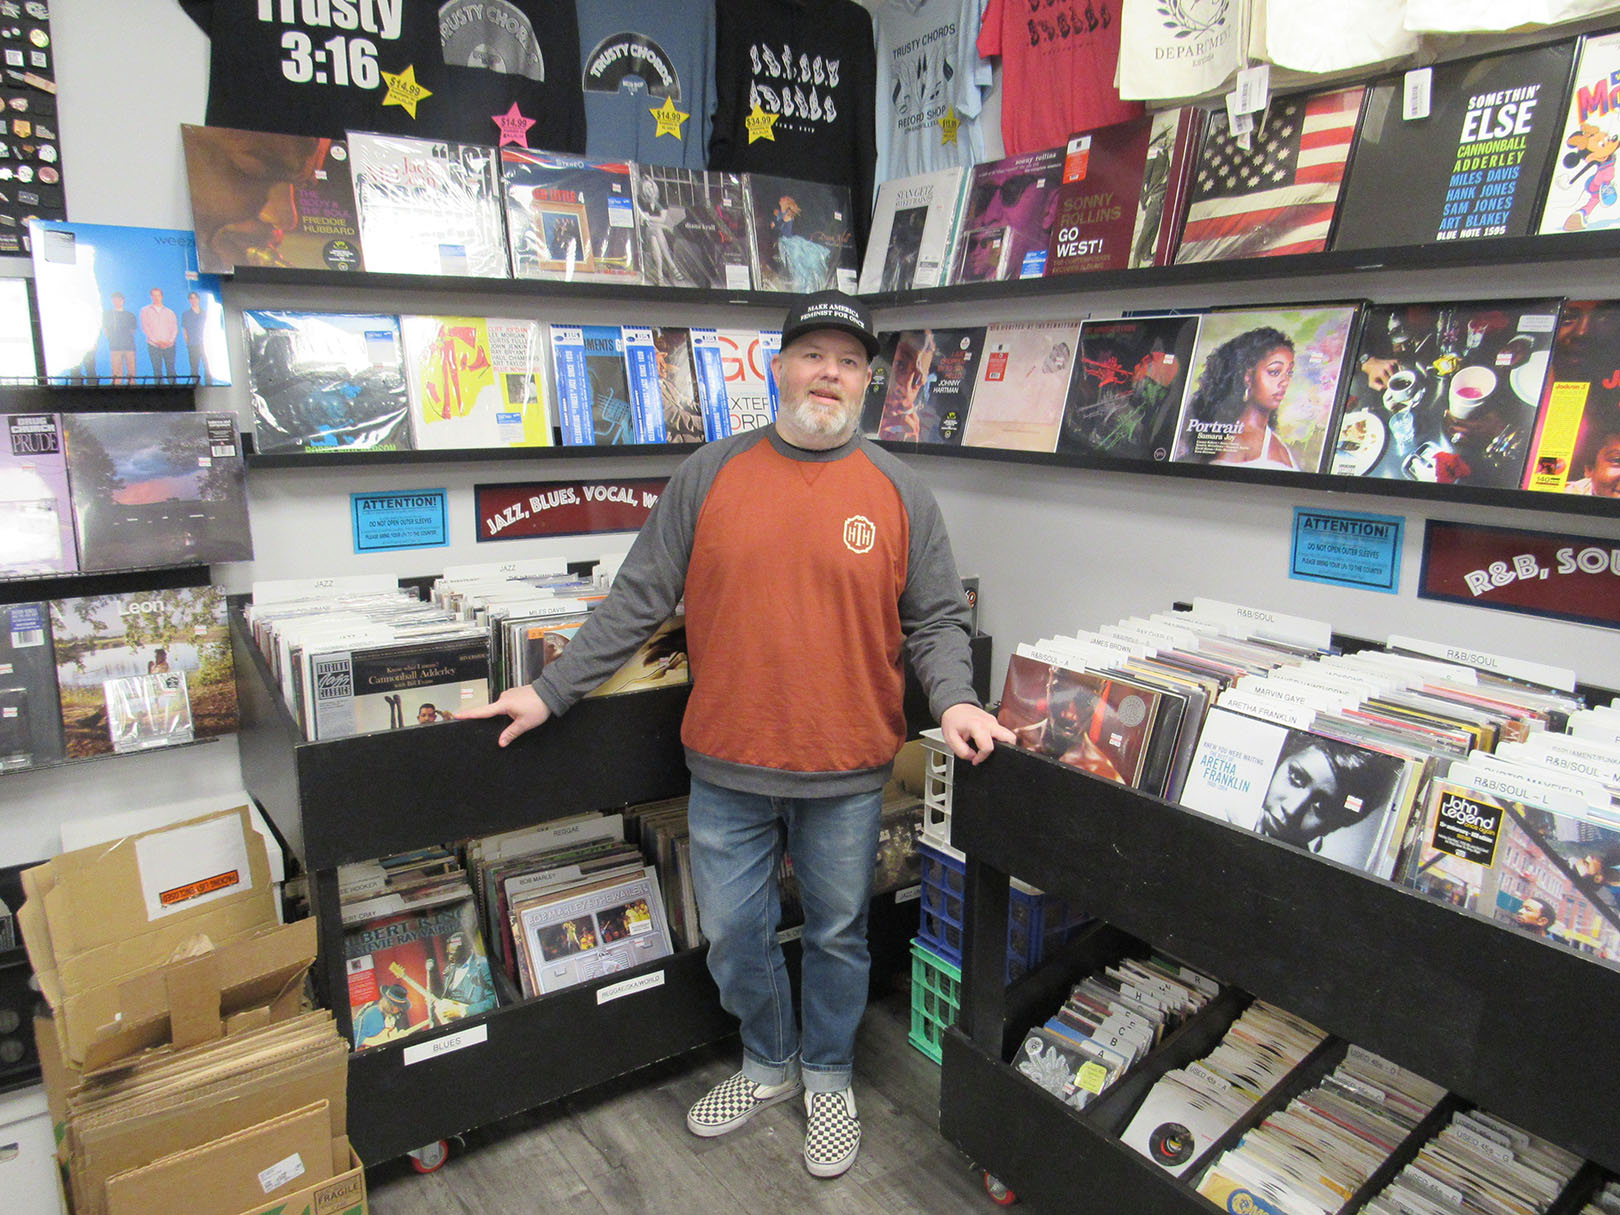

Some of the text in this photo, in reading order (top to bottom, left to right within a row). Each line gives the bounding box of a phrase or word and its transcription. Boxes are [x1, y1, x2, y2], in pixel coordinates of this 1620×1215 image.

[440, 4, 484, 48] RUSTY
[893, 24, 956, 60] TRUSTY CHORDS
[281, 31, 380, 90] 3:16
[590, 43, 673, 87] TRUSTY CHORDS
[389, 76, 422, 97] $14.99
[1468, 84, 1541, 111] SOMETHIN'
[501, 118, 527, 129] $14.99
[657, 111, 681, 121] $14.99
[747, 116, 771, 127] $34.99
[898, 111, 925, 129] RECORD
[926, 105, 946, 121] SHOP
[1460, 99, 1538, 144] ELSE
[1457, 136, 1526, 159] CANNONBALL
[1015, 152, 1057, 166] sonny rollins
[1453, 150, 1526, 173] ADDERLEY
[1449, 166, 1521, 188] MILES DAVIS
[550, 189, 585, 204] LITTLE 4
[1446, 181, 1517, 202] HANK JONES
[1063, 192, 1113, 211] SONNY
[1442, 196, 1514, 216] SAM JONES
[303, 216, 346, 226] FREDDIE
[1060, 206, 1121, 226] ROLLINS
[1439, 211, 1510, 230] ART BLAKEY
[304, 225, 355, 235] HUBBARD
[1058, 226, 1079, 242] GO
[1436, 225, 1508, 241] BLUE NOTE 1595
[1057, 239, 1103, 258] WEST!
[800, 311, 865, 329] FEMINIST FOR ONCE
[807, 304, 860, 318] MAKE AMERICA
[937, 379, 960, 387] JOHNNY
[11, 424, 56, 433] CHURCH
[17, 417, 47, 426] DRUG
[1186, 418, 1245, 434] Portrait
[12, 432, 59, 454] PRUDE
[1197, 433, 1237, 443] Samara Joy
[362, 496, 437, 510] ATTENTION!
[486, 503, 530, 536] JAZZ,
[529, 488, 580, 514] BLUES,
[582, 485, 638, 508] VOCAL,
[378, 519, 386, 527] NOT
[401, 517, 414, 526] OUTER
[415, 517, 432, 525] SLEEVES
[1304, 517, 1389, 538] ATTENTION!
[847, 521, 871, 547] HTH
[1307, 542, 1380, 560] DO NOT OPEN OUTER SLEEVES
[500, 564, 516, 572] JAZZ
[1463, 553, 1551, 598] R&B,
[315, 580, 334, 589] JAZZ
[118, 599, 165, 616] Leon
[528, 607, 567, 617] MILES DAVIS
[1237, 608, 1276, 623] R&B/SOUL
[1090, 639, 1109, 649] JAMES
[1109, 642, 1132, 653] BROWN
[1030, 650, 1059, 666] R&B/SOUL
[1446, 649, 1499, 669] R&B/SOUL
[319, 674, 351, 689] Jazz
[368, 667, 456, 686] Cannonball Adderley
[1254, 685, 1282, 700] MARVIN
[1283, 693, 1305, 705] GAYE
[1227, 699, 1297, 724] ARETHA FRANKLIN
[1203, 742, 1218, 750] KNEW
[1228, 748, 1243, 757] WERE
[1243, 753, 1264, 766] WAITING
[1200, 754, 1236, 776] ARETHA
[1545, 756, 1600, 777] R&B/SOUL
[1203, 769, 1251, 793] FRANKLIN
[1474, 776, 1529, 800] R&B/SOUL
[1543, 794, 1549, 804] L
[1446, 795, 1478, 816] John
[1441, 802, 1495, 830] Legend
[554, 825, 580, 837] REGGAE
[1464, 822, 1496, 836] once again
[162, 874, 236, 903] PACKING LIST ENCLOSED
[354, 881, 377, 894] HOOKER
[519, 873, 558, 886] BOB MARLEY
[528, 885, 651, 926] BOB MARLEY THE WAILERS
[358, 910, 377, 921] CRAY
[397, 930, 418, 945] RAY
[601, 974, 660, 998] REGGAE/SKA/WORLD
[1194, 976, 1201, 985] R
[1135, 991, 1143, 1002] H
[1118, 1026, 1126, 1037] C
[432, 1036, 463, 1051] BLUES
[1110, 1036, 1118, 1048] B
[1098, 1049, 1105, 1058] A
[1189, 1065, 1207, 1080] USED
[1456, 1130, 1479, 1147] USED
[1481, 1142, 1494, 1155] 45s
[1407, 1170, 1428, 1186] USED
[318, 1182, 359, 1204] FRAGILE
